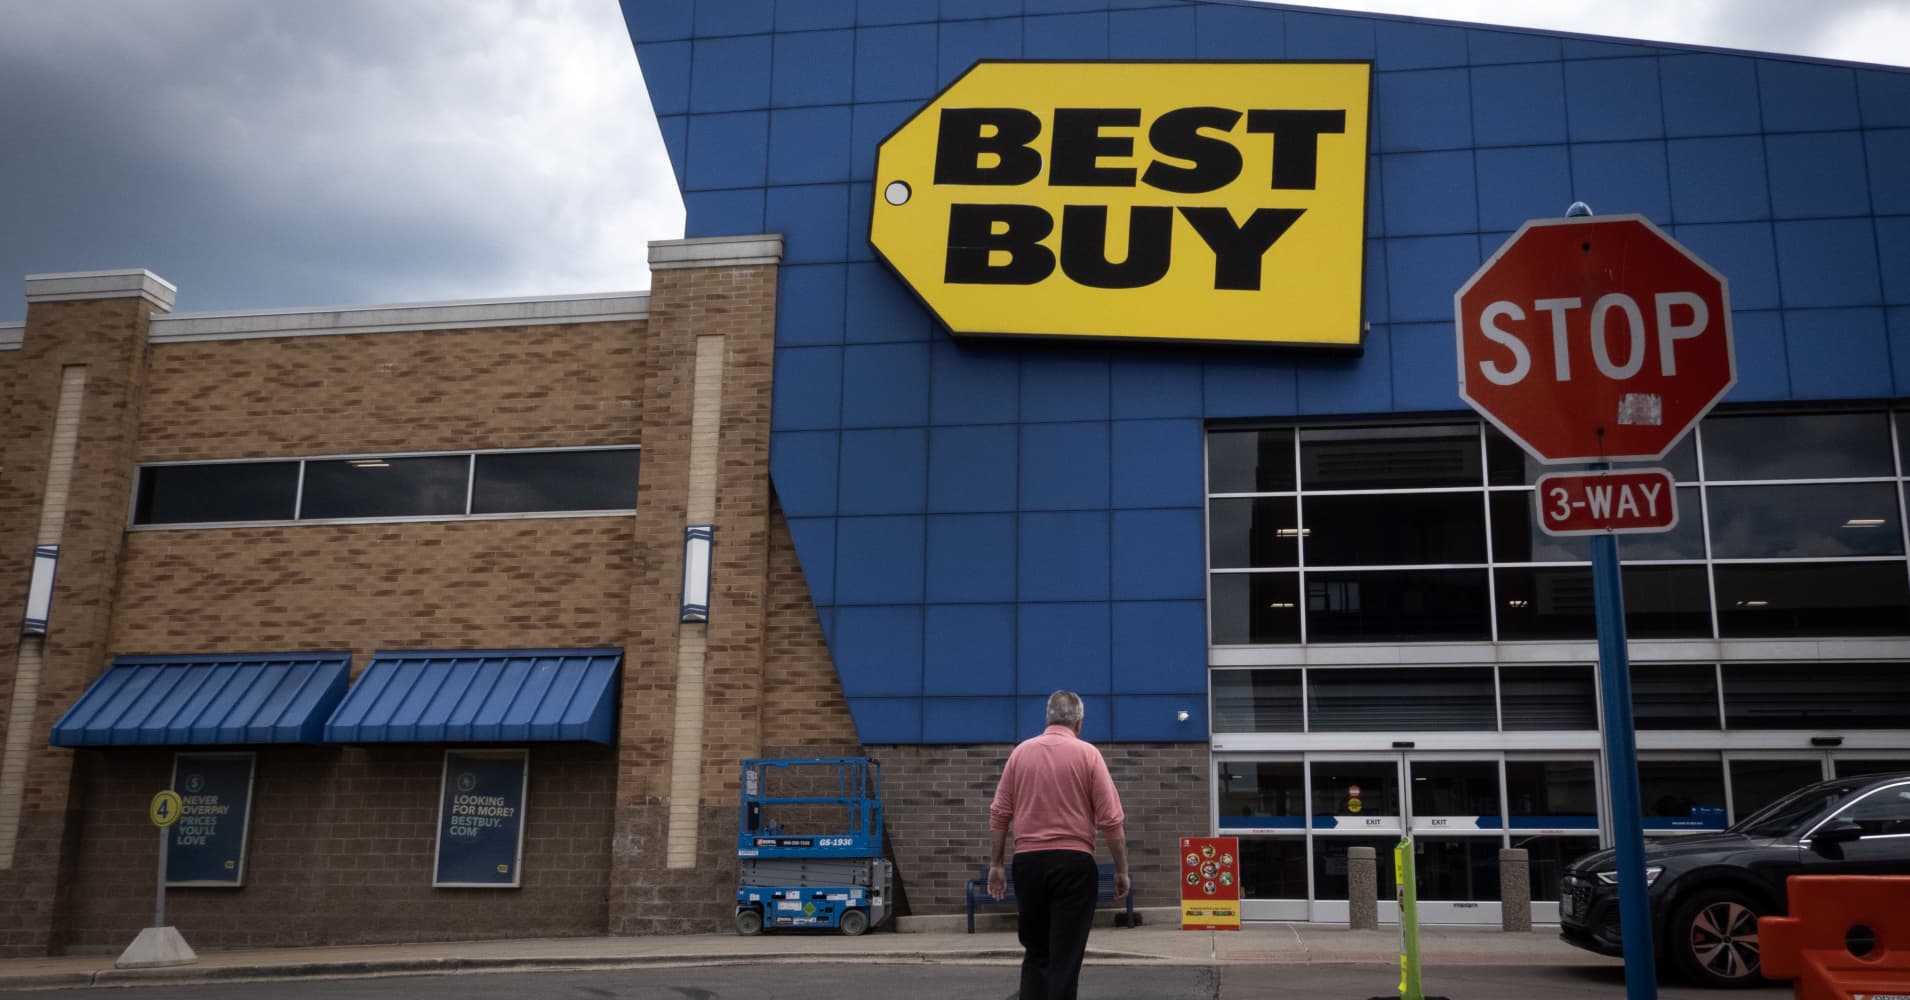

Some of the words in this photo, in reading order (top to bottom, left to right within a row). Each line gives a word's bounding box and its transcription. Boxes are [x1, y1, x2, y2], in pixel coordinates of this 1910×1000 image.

[933, 106, 1346, 194] BEST
[944, 203, 1308, 291] BUY
[1479, 291, 1709, 386] STOP
[1550, 483, 1662, 521] 3-WAY
[183, 795, 218, 805] NEVER
[454, 795, 504, 806] LOOKING
[157, 799, 169, 819] 4
[182, 805, 229, 815] OVERPAY
[452, 805, 476, 815] FOR
[478, 807, 515, 817] MORE?
[180, 816, 217, 826] PRICES
[451, 816, 502, 828] BESTBUY.
[450, 826, 477, 837] COM
[177, 836, 206, 845] LOVE
[819, 838, 853, 847] GS-1930
